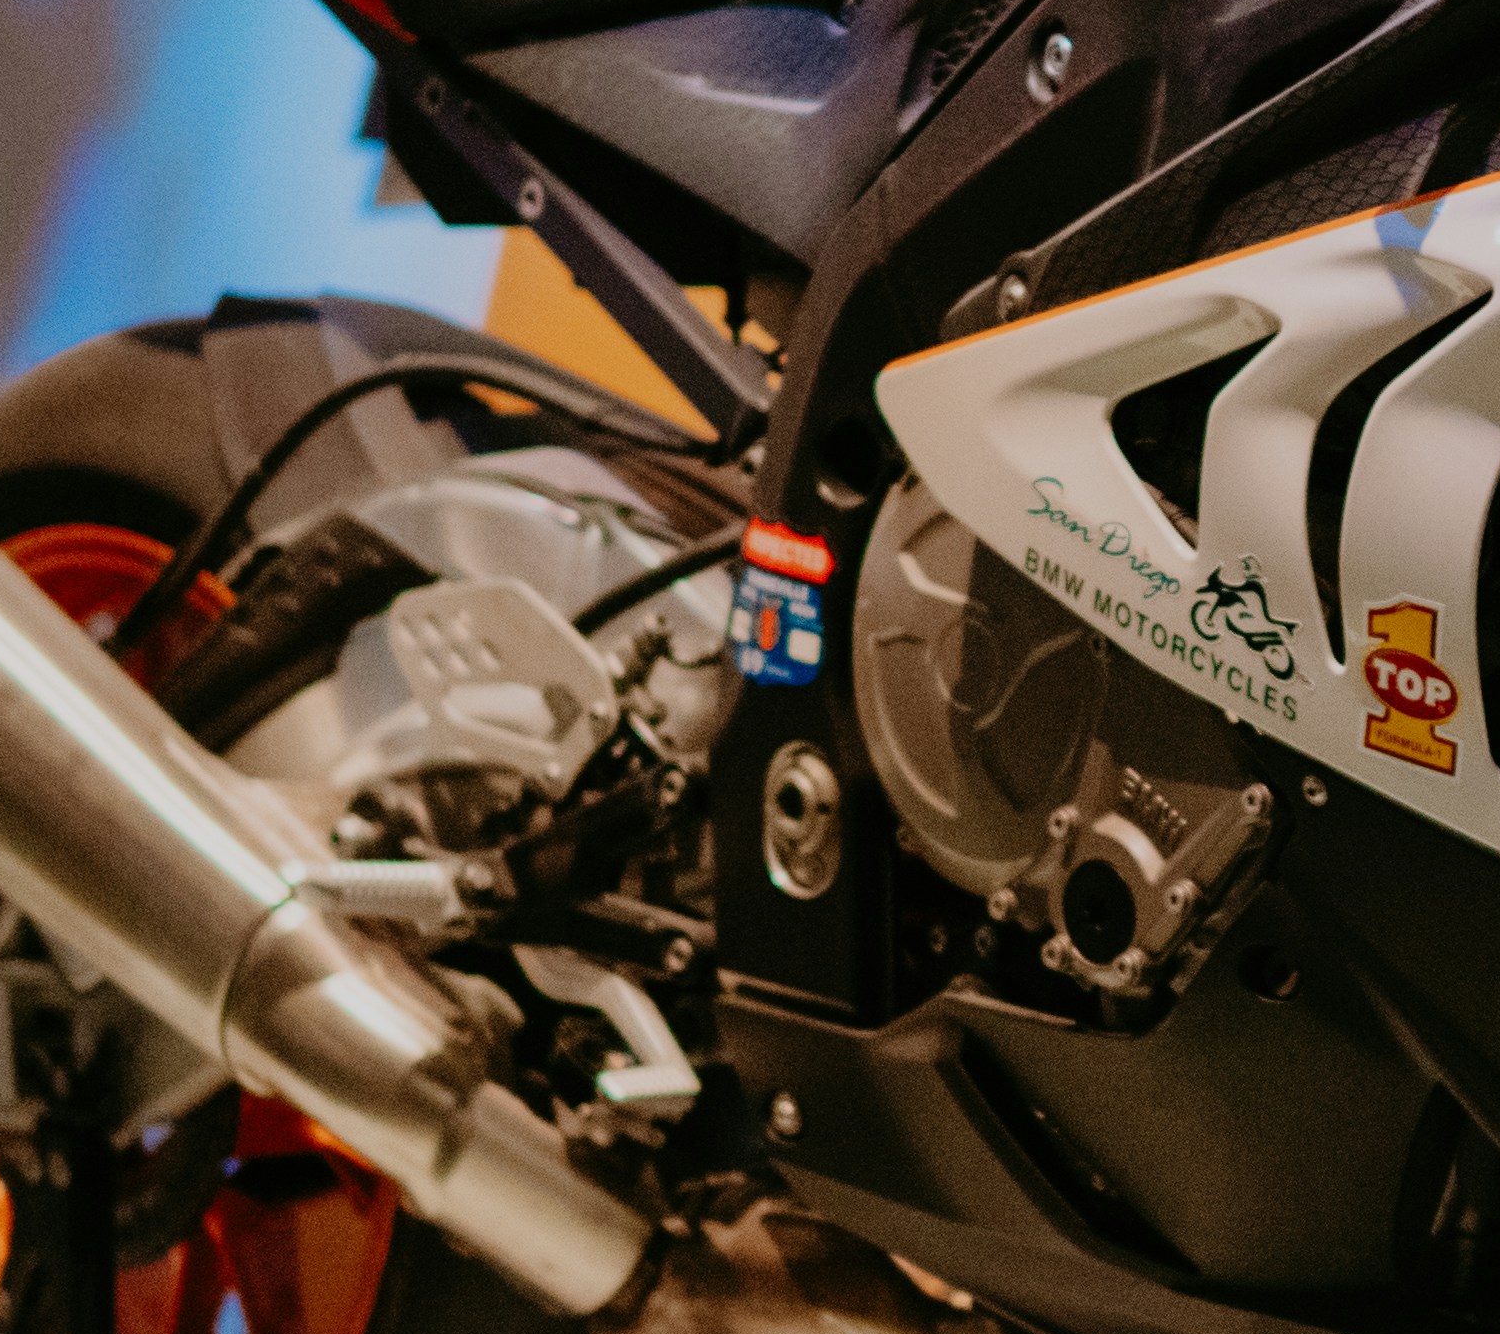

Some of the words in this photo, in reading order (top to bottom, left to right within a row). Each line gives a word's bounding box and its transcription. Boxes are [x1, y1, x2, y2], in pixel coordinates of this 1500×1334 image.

[1027, 475, 1093, 544] San
[1099, 521, 1182, 600] Diego
[1023, 547, 1085, 601] BMW
[1093, 588, 1298, 723] MOTORCYCLES
[1372, 656, 1452, 708] TOP
